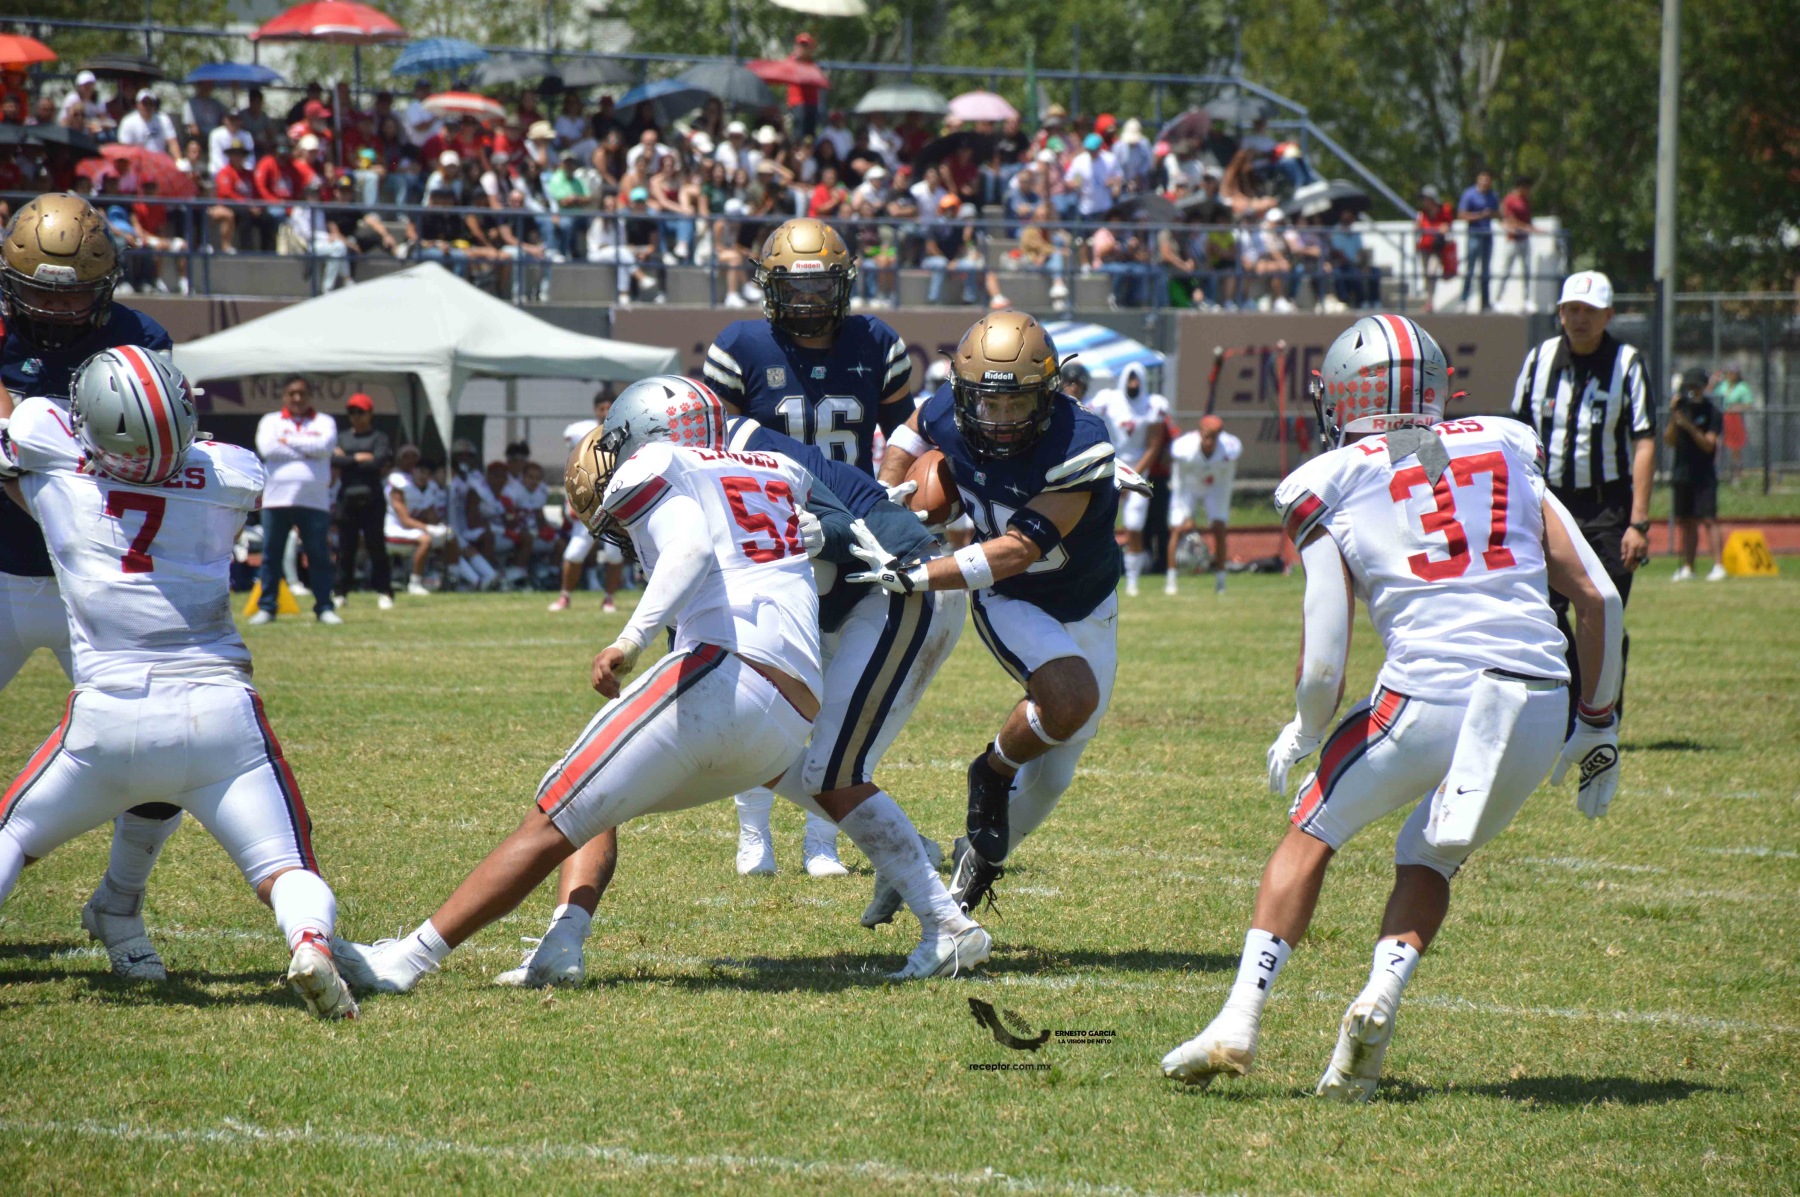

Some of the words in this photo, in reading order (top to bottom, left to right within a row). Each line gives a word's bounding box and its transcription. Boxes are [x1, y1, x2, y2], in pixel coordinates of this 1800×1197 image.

[984, 371, 1014, 380] Riddell
[775, 394, 864, 466] 16
[106, 490, 166, 574] 7
[719, 476, 807, 564] 52
[1389, 451, 1517, 583] 37
